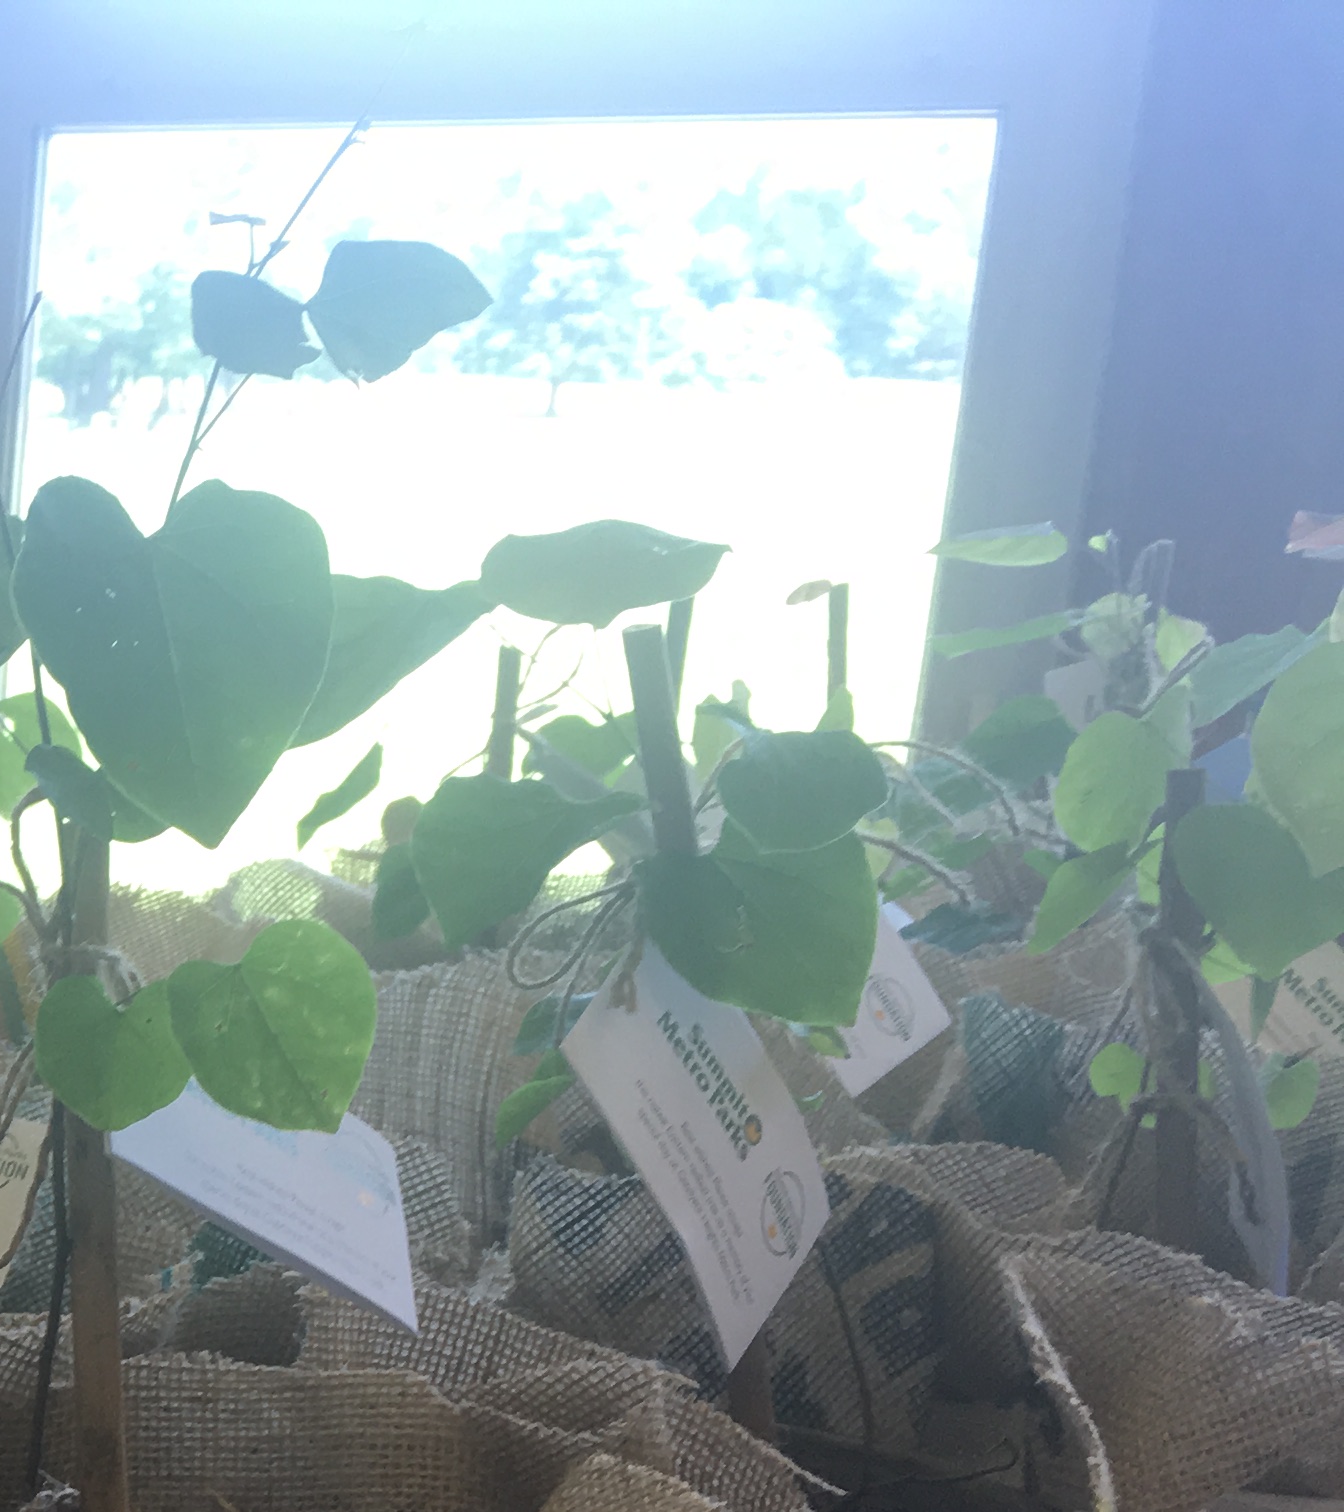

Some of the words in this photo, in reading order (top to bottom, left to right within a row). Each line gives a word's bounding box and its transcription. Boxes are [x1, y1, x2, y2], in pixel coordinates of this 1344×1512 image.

[656, 1008, 710, 1093] Metro
[707, 1084, 749, 1162] Parks
[687, 1022, 750, 1119] Summit
